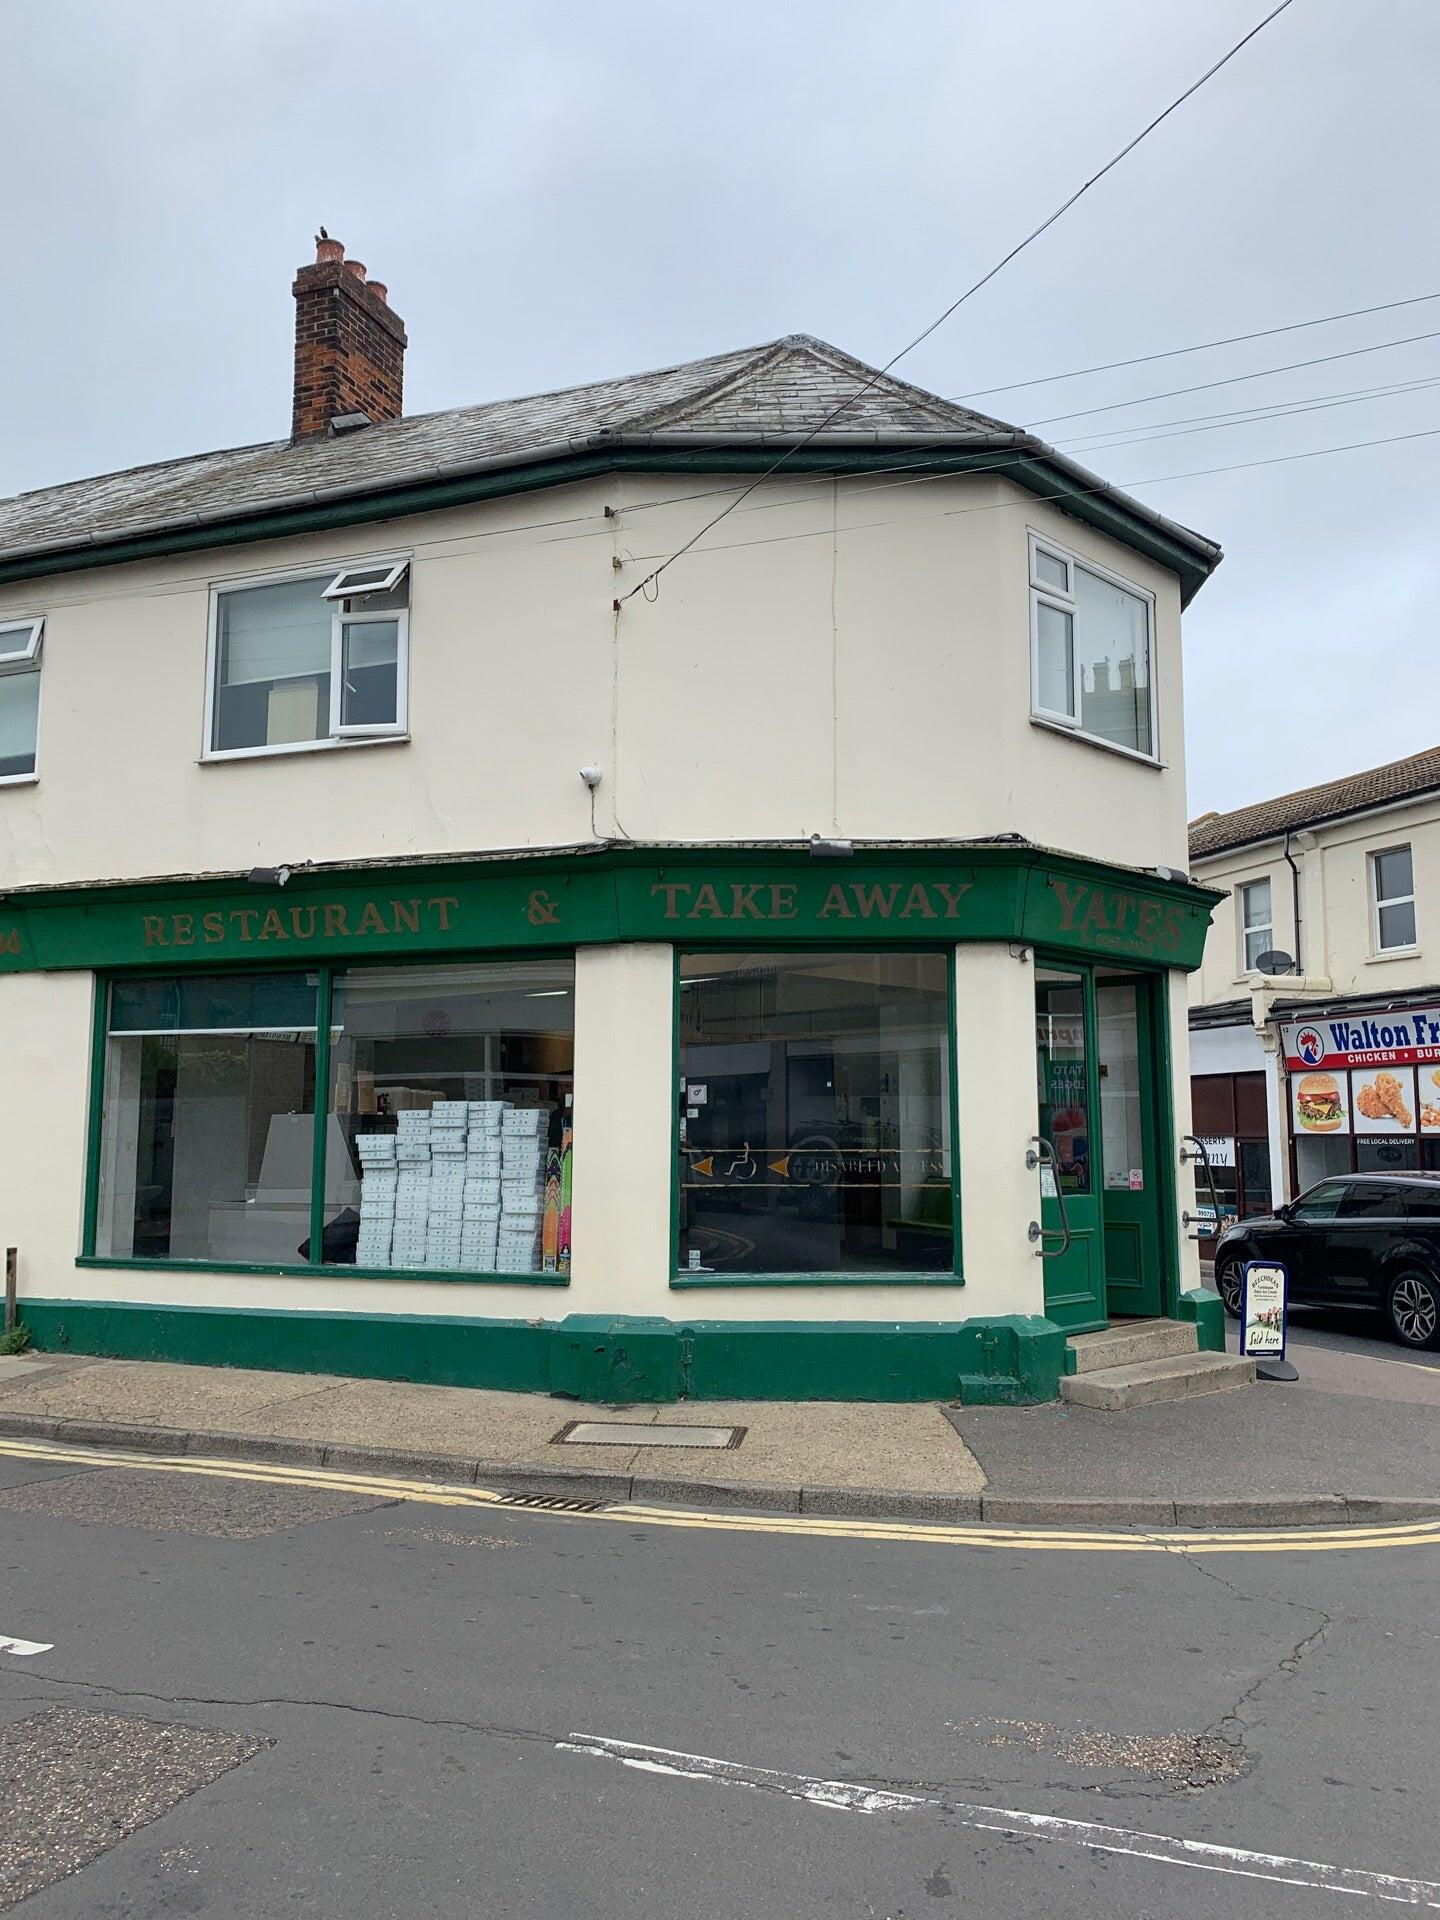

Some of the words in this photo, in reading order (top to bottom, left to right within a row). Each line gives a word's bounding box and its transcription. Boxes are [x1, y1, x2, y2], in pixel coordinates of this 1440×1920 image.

[650, 883, 800, 919] TAKE
[816, 883, 974, 919] AWAY
[1052, 880, 1185, 951] YATES
[142, 896, 460, 947] RESTAURANT
[528, 890, 561, 925] &
[1329, 1020, 1411, 1052] Walton
[1347, 1051, 1396, 1063] CHICKEN
[1417, 1048, 1440, 1059] BUR
[1249, 1330, 1264, 1345] Sold
[1264, 1330, 1280, 1344] here
